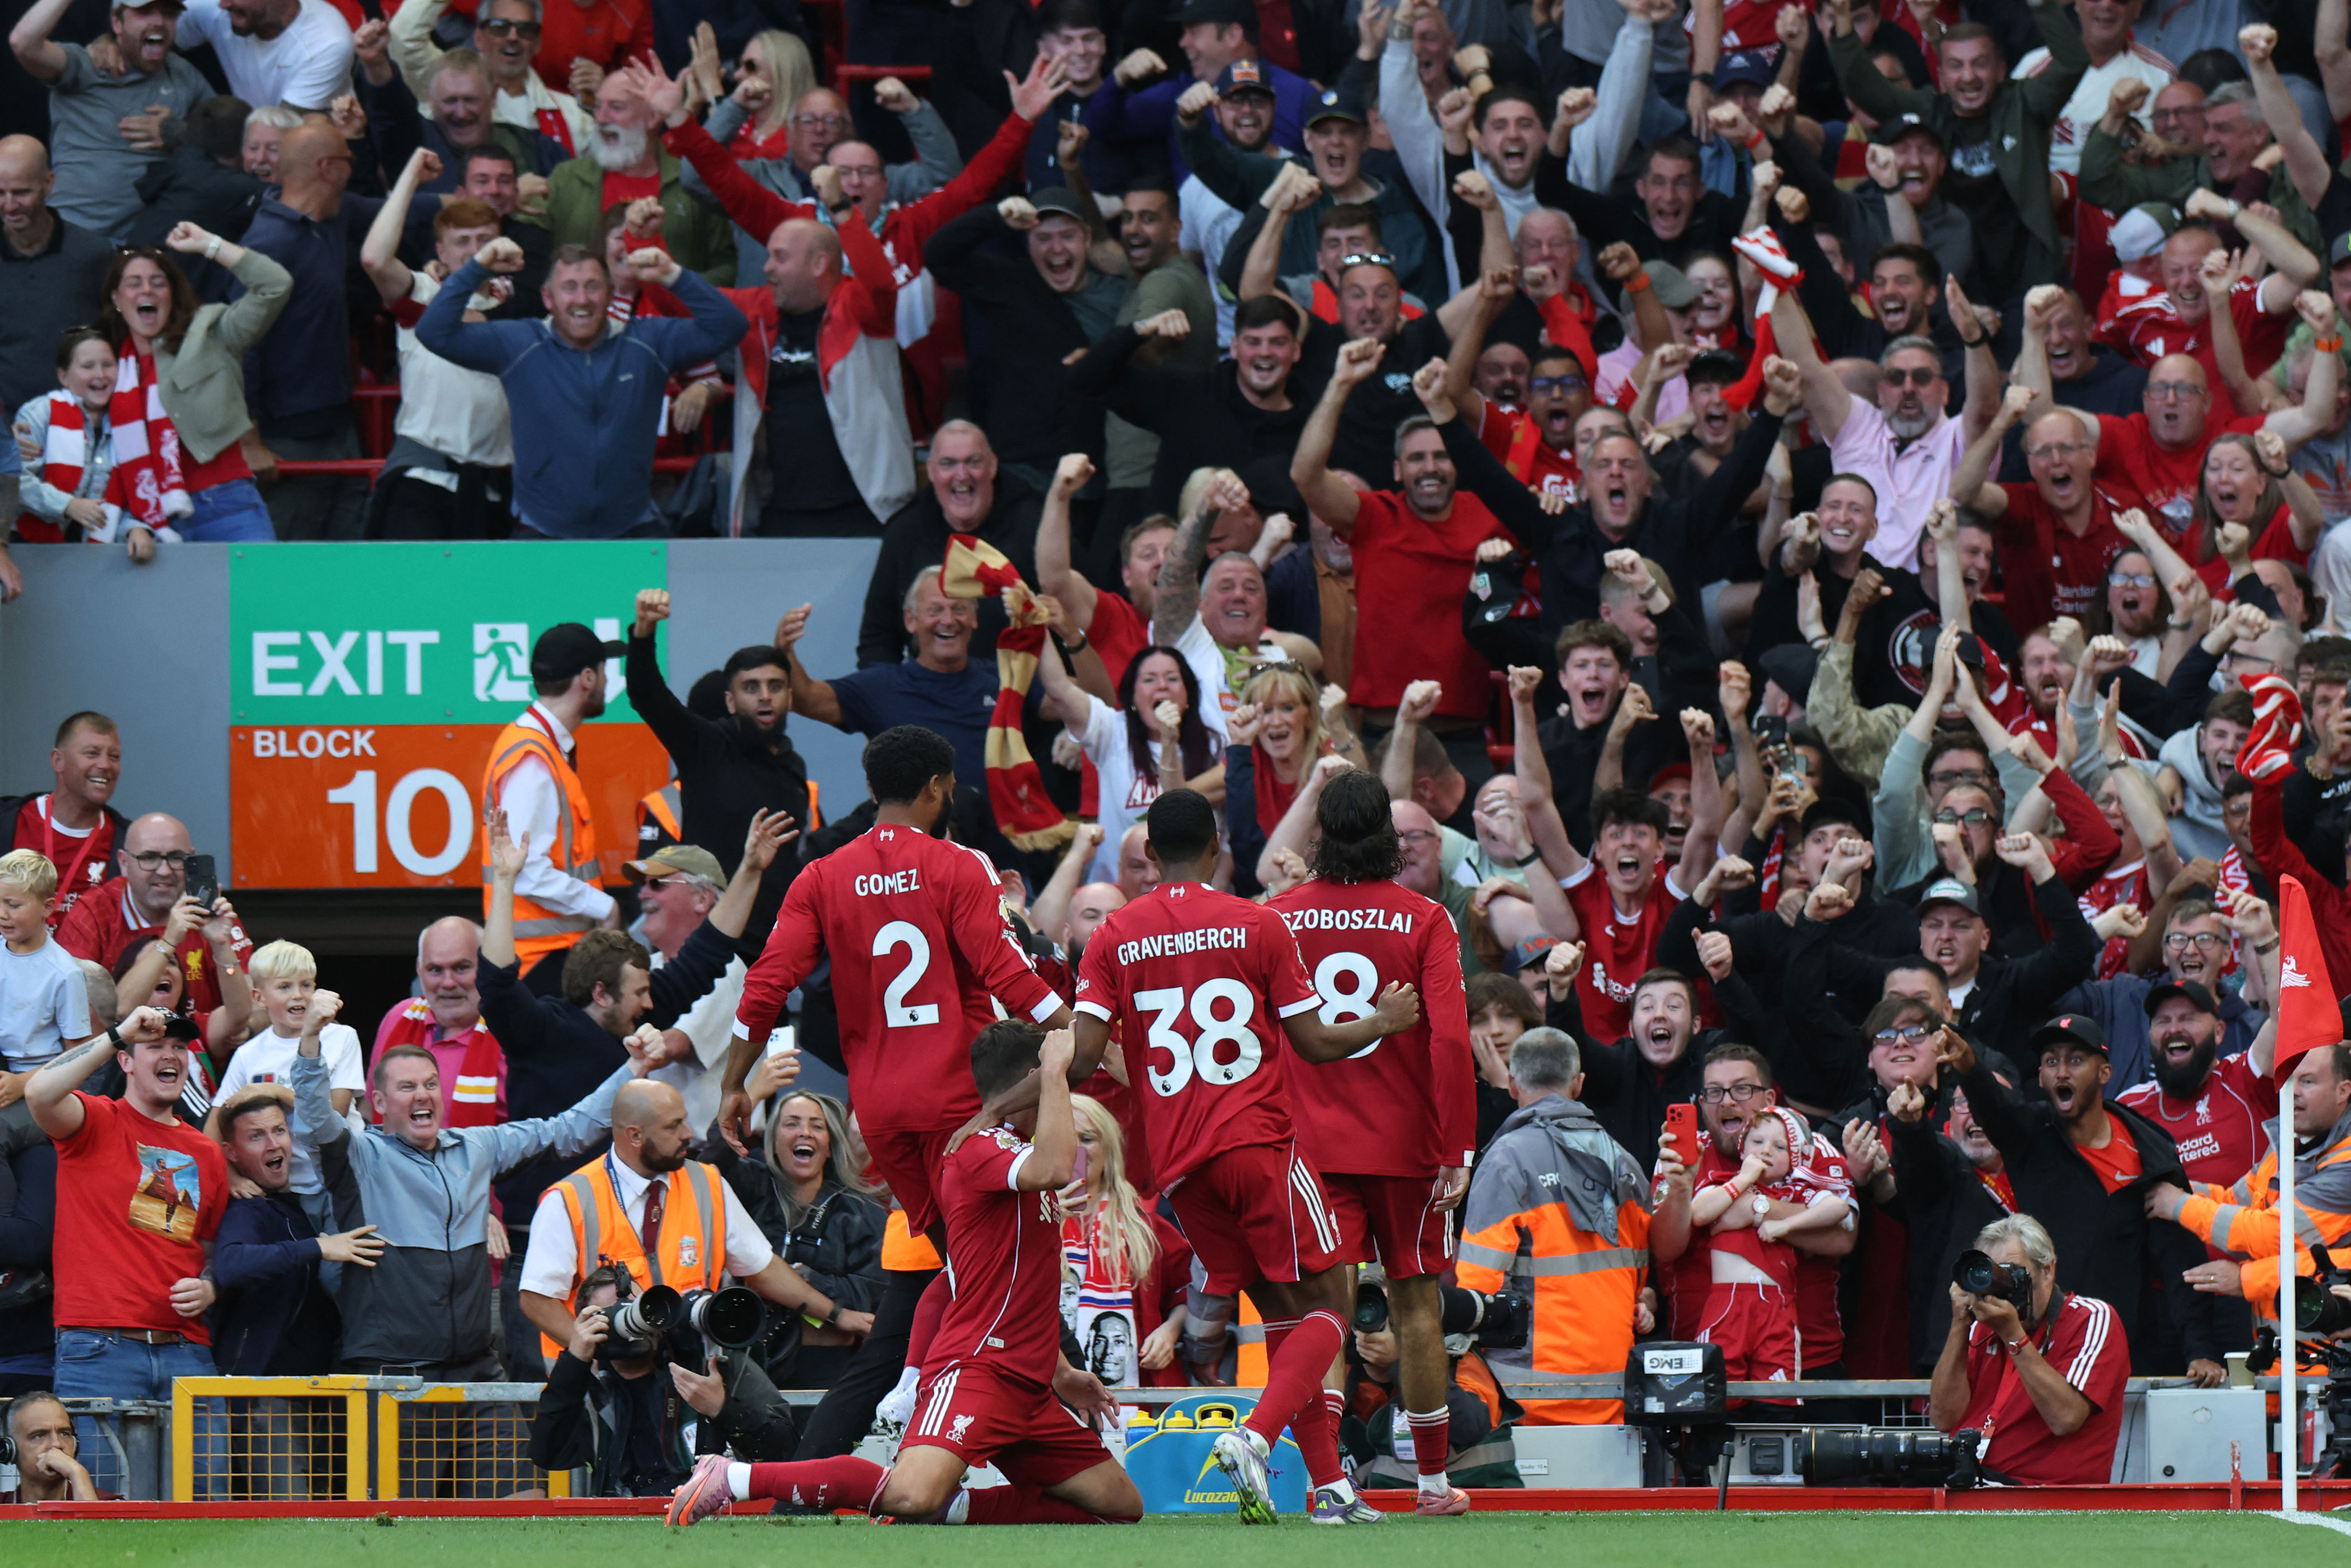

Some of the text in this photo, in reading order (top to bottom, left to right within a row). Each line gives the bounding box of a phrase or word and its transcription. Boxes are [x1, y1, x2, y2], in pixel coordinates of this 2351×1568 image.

[253, 631, 439, 695] EXIT
[254, 729, 377, 759] BLOCK
[328, 768, 474, 877] 10
[855, 868, 920, 897] GOMEZ
[1281, 908, 1413, 935] SZOBOSZLAI
[1117, 927, 1246, 966] GRAVENBERCH
[872, 921, 940, 1028] 2
[1076, 979, 1089, 994] edia
[1314, 951, 1379, 1059] 8
[1133, 978, 1262, 1097] 38
[2175, 1132, 2213, 1153] ndard
[2179, 1141, 2221, 1164] rtered
[1649, 1357, 1683, 1370] EMG
[1184, 1489, 1240, 1503] Lucozad
